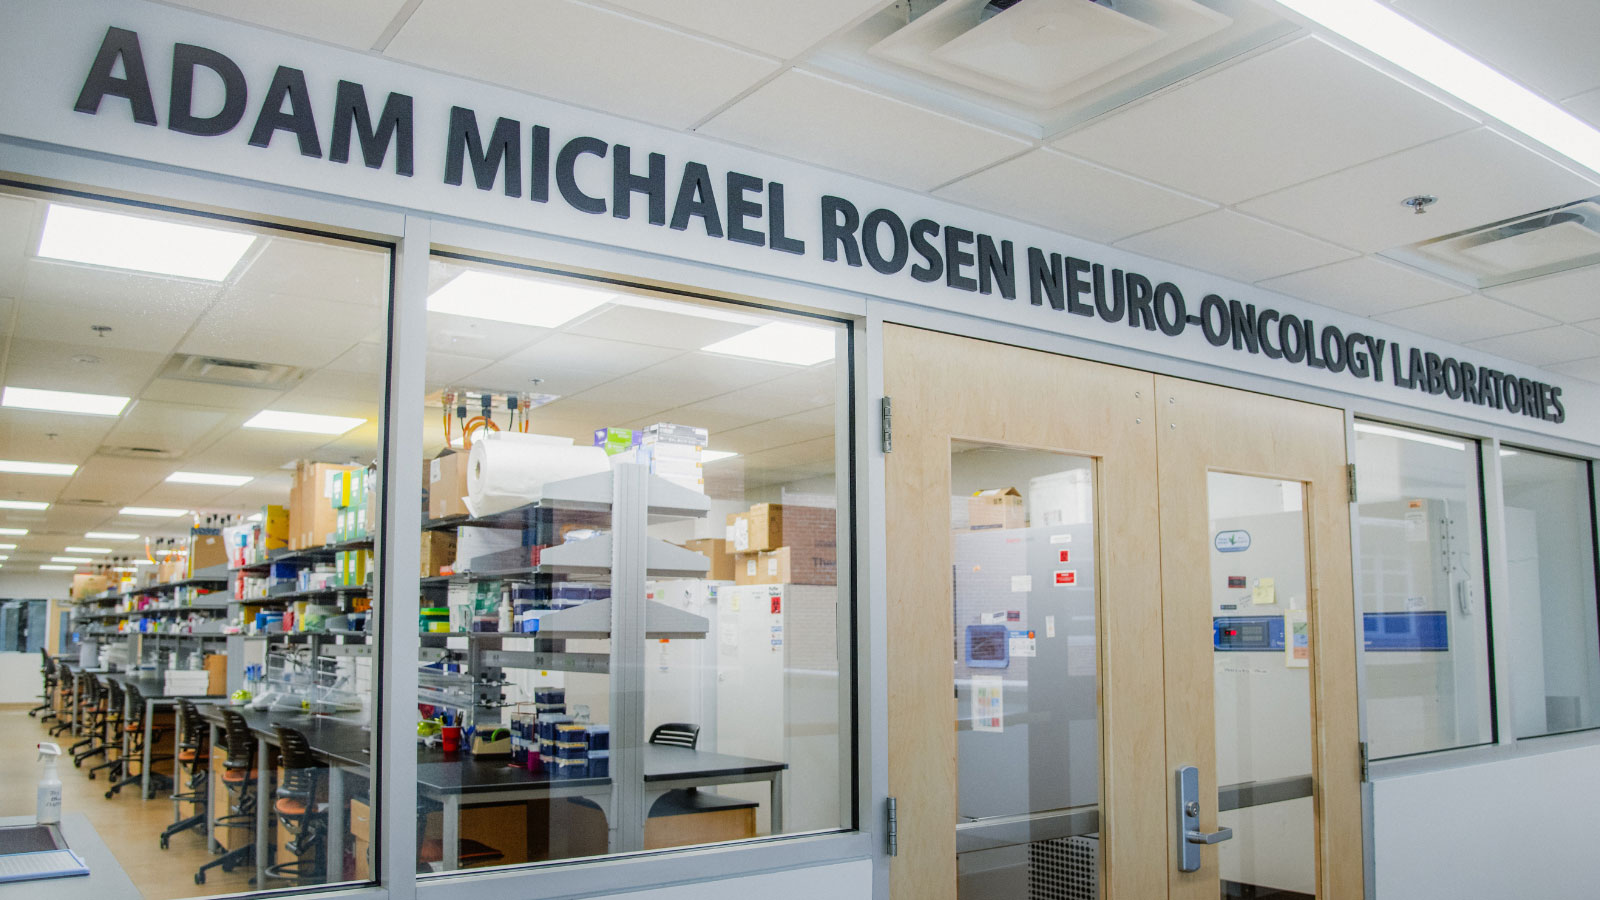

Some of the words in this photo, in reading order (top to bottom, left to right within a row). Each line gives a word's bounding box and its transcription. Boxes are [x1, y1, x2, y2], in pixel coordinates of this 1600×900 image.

[73, 25, 414, 177] ADAM
[443, 105, 805, 255] MICHAEL
[821, 194, 1017, 301] ROSEN
[1027, 246, 1386, 382] NEURO-ONCOLOGY
[1390, 342, 1566, 424] LABORATORIES
